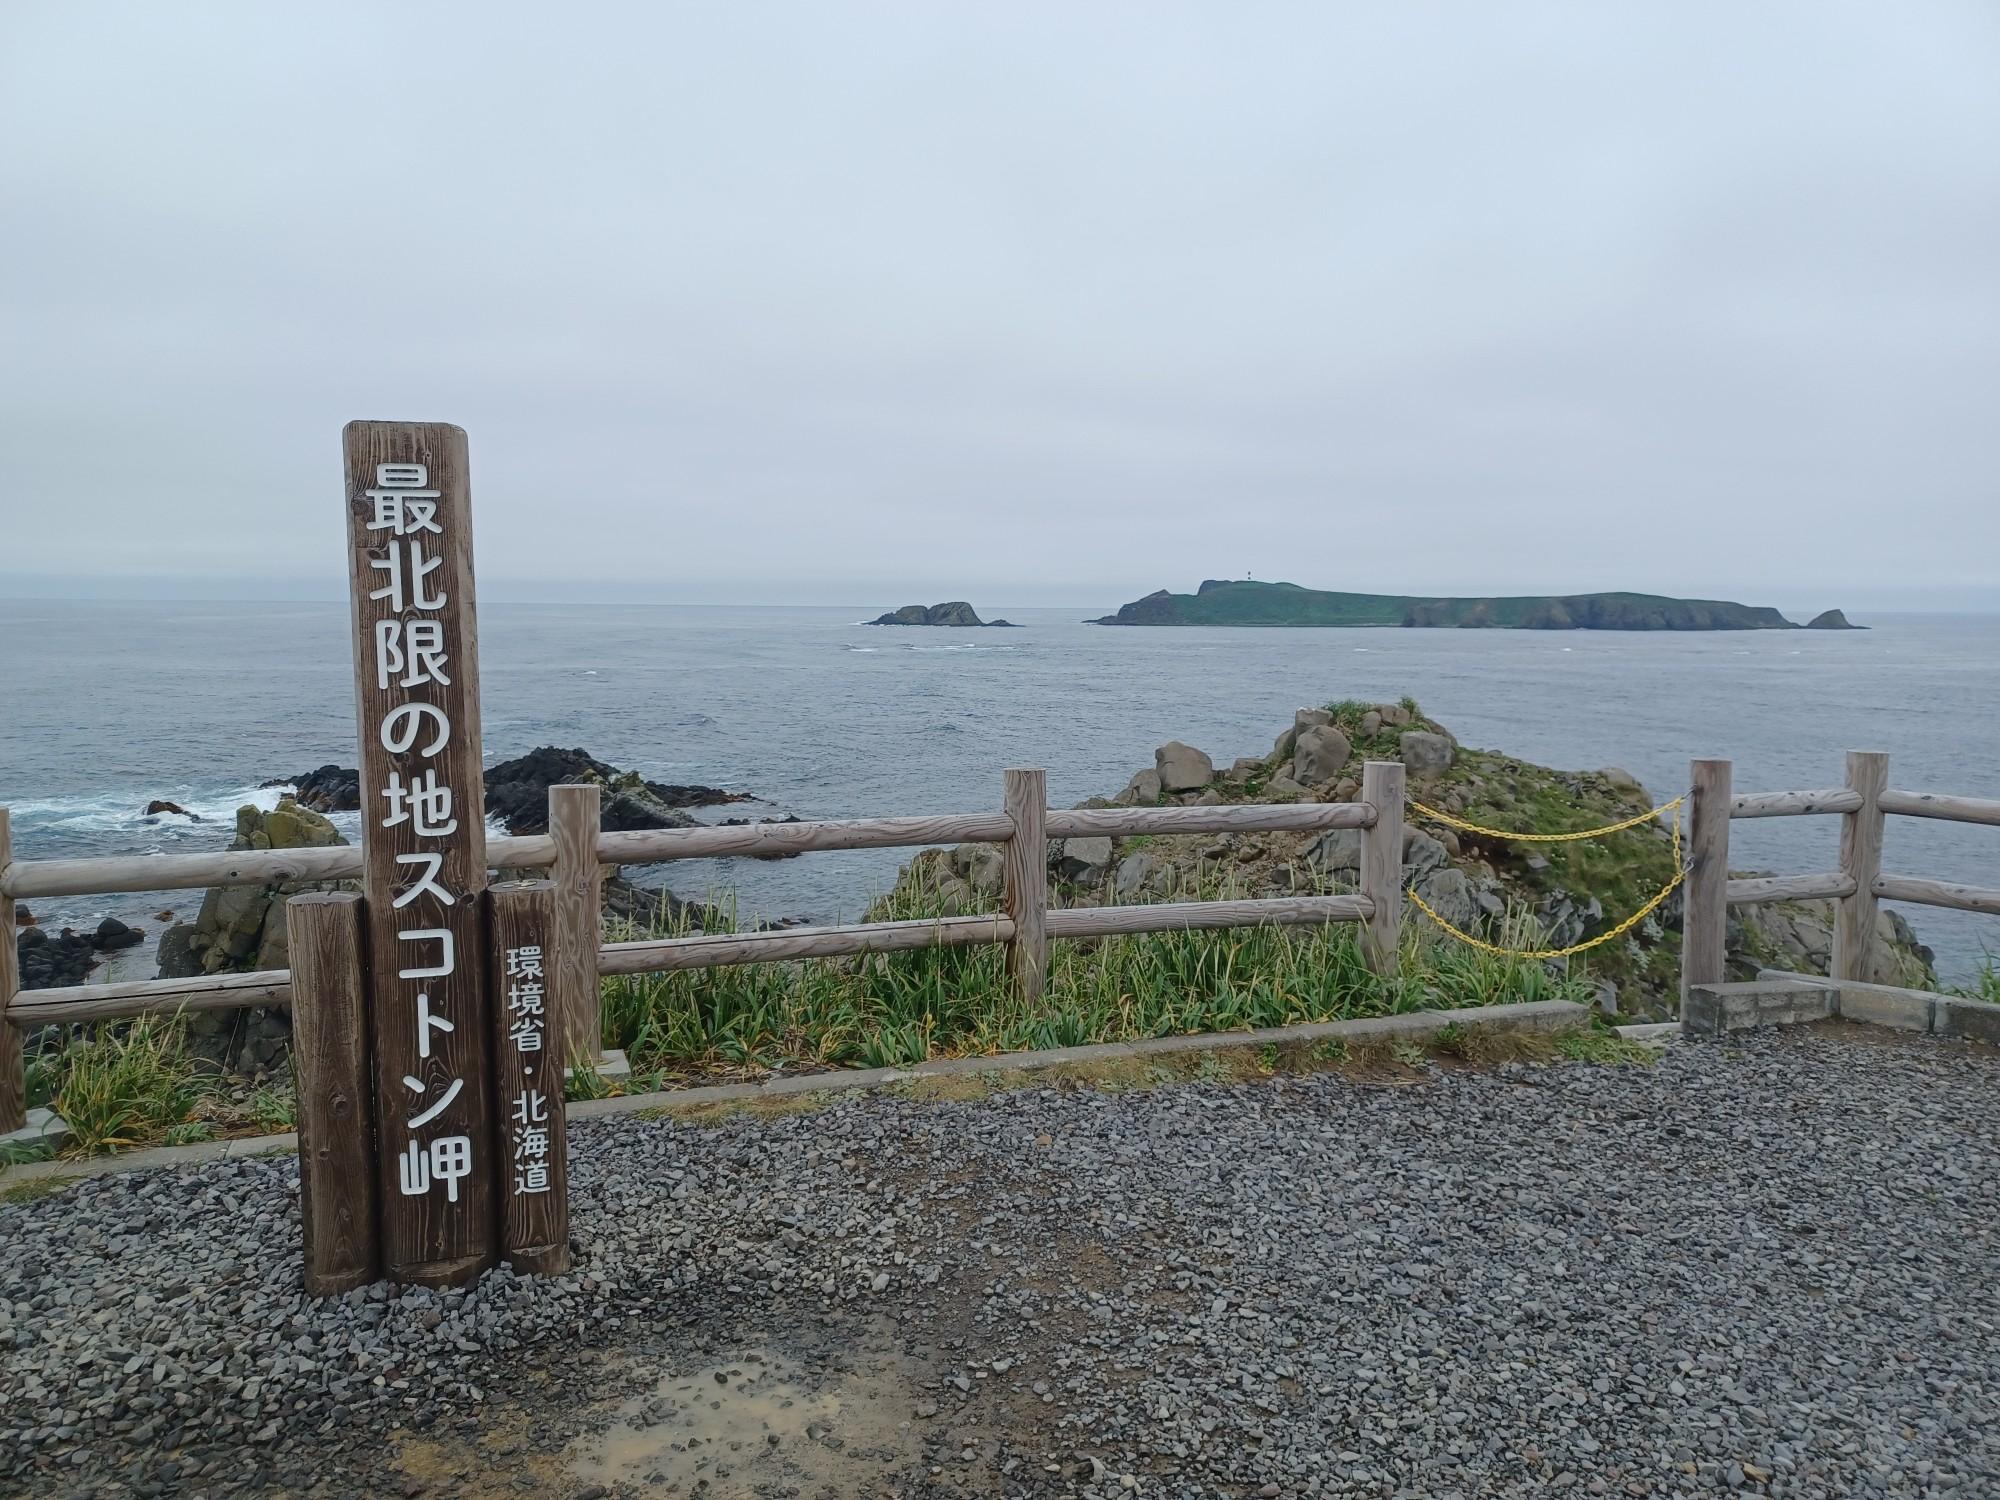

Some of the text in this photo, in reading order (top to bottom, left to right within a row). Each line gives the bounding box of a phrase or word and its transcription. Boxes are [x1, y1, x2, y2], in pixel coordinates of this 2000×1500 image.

[365, 462, 473, 1204] 最北限の地スコトン岬
[506, 945, 551, 1196] 環境省・北海道
